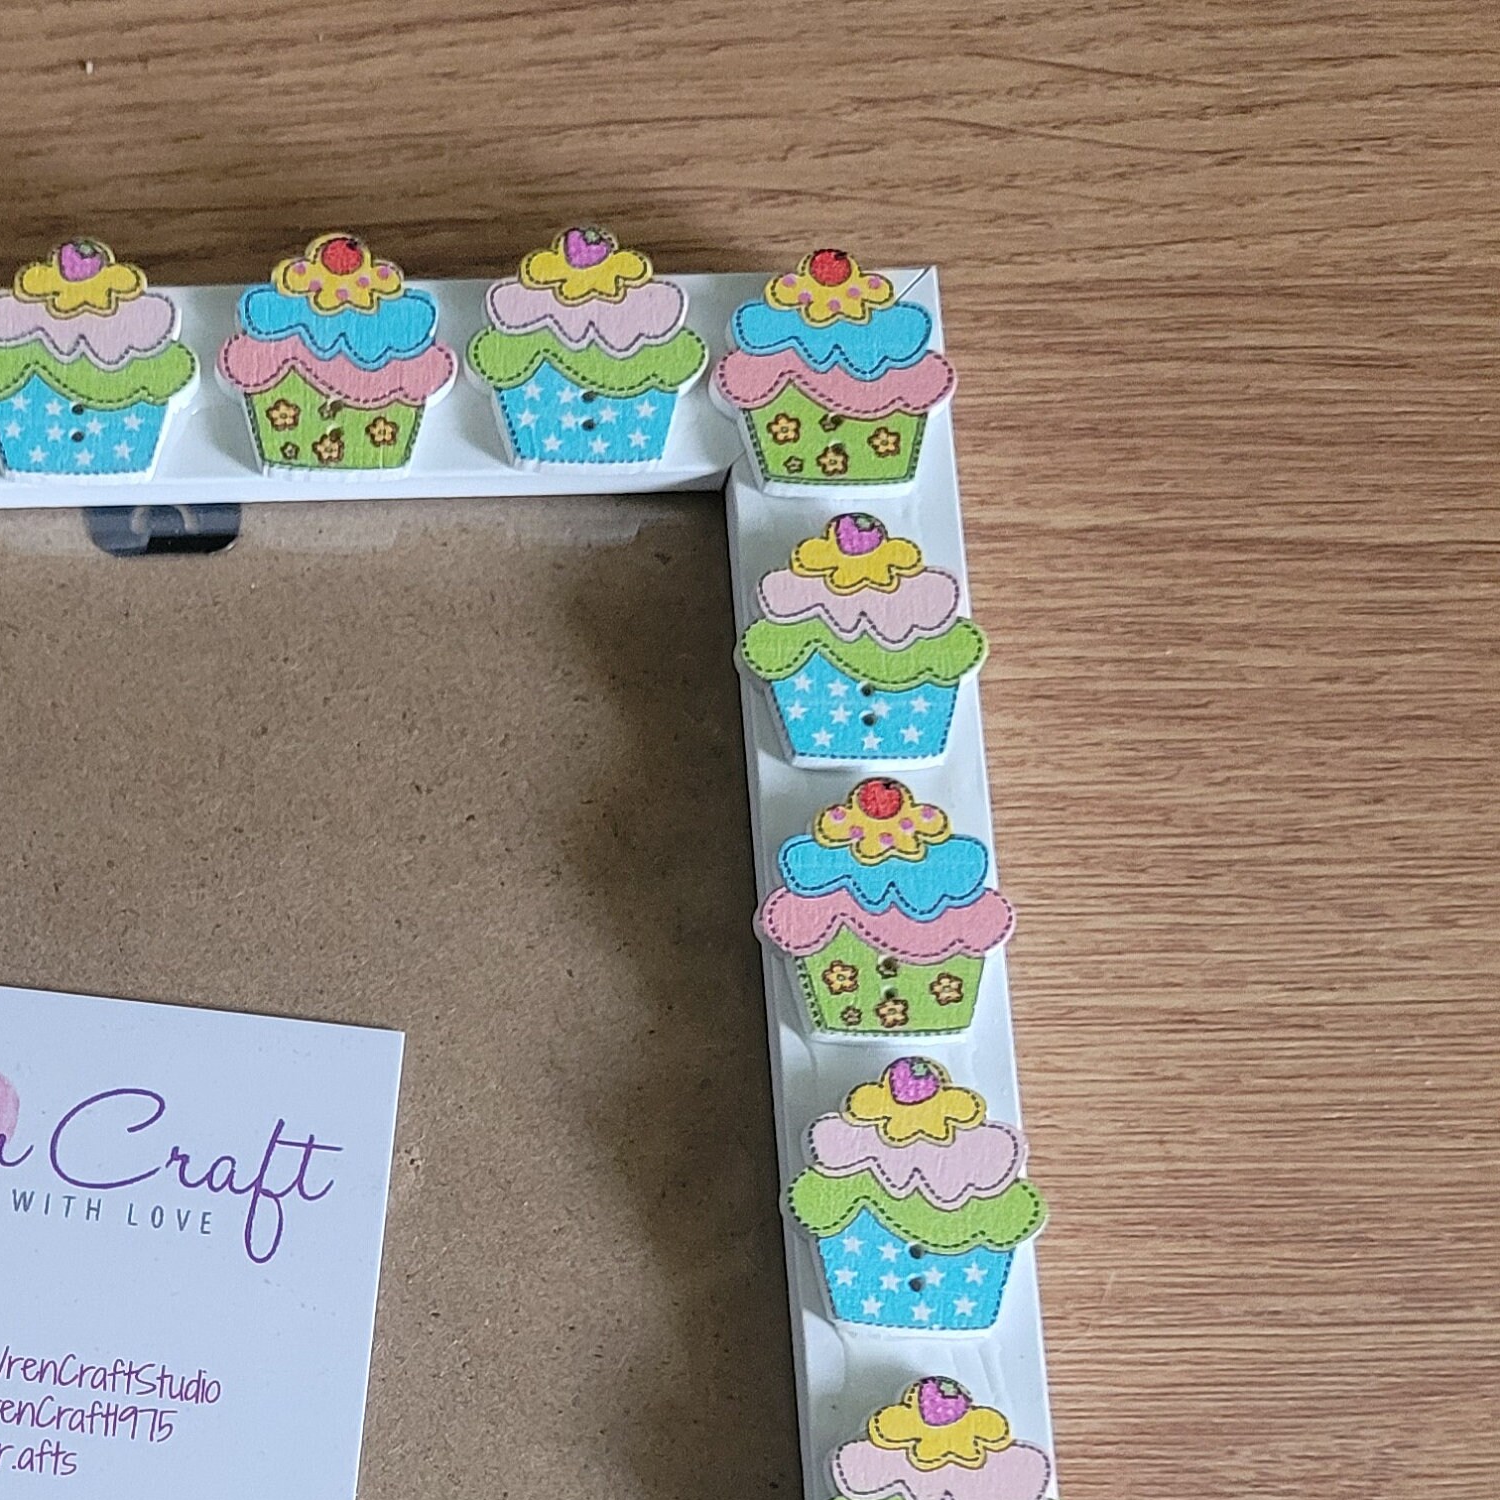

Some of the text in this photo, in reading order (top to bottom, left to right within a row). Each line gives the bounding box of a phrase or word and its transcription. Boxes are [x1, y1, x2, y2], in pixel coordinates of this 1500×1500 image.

[12, 1189, 103, 1222] WITH
[127, 1202, 213, 1236] LOVE
[49, 1087, 343, 1263] Craft
